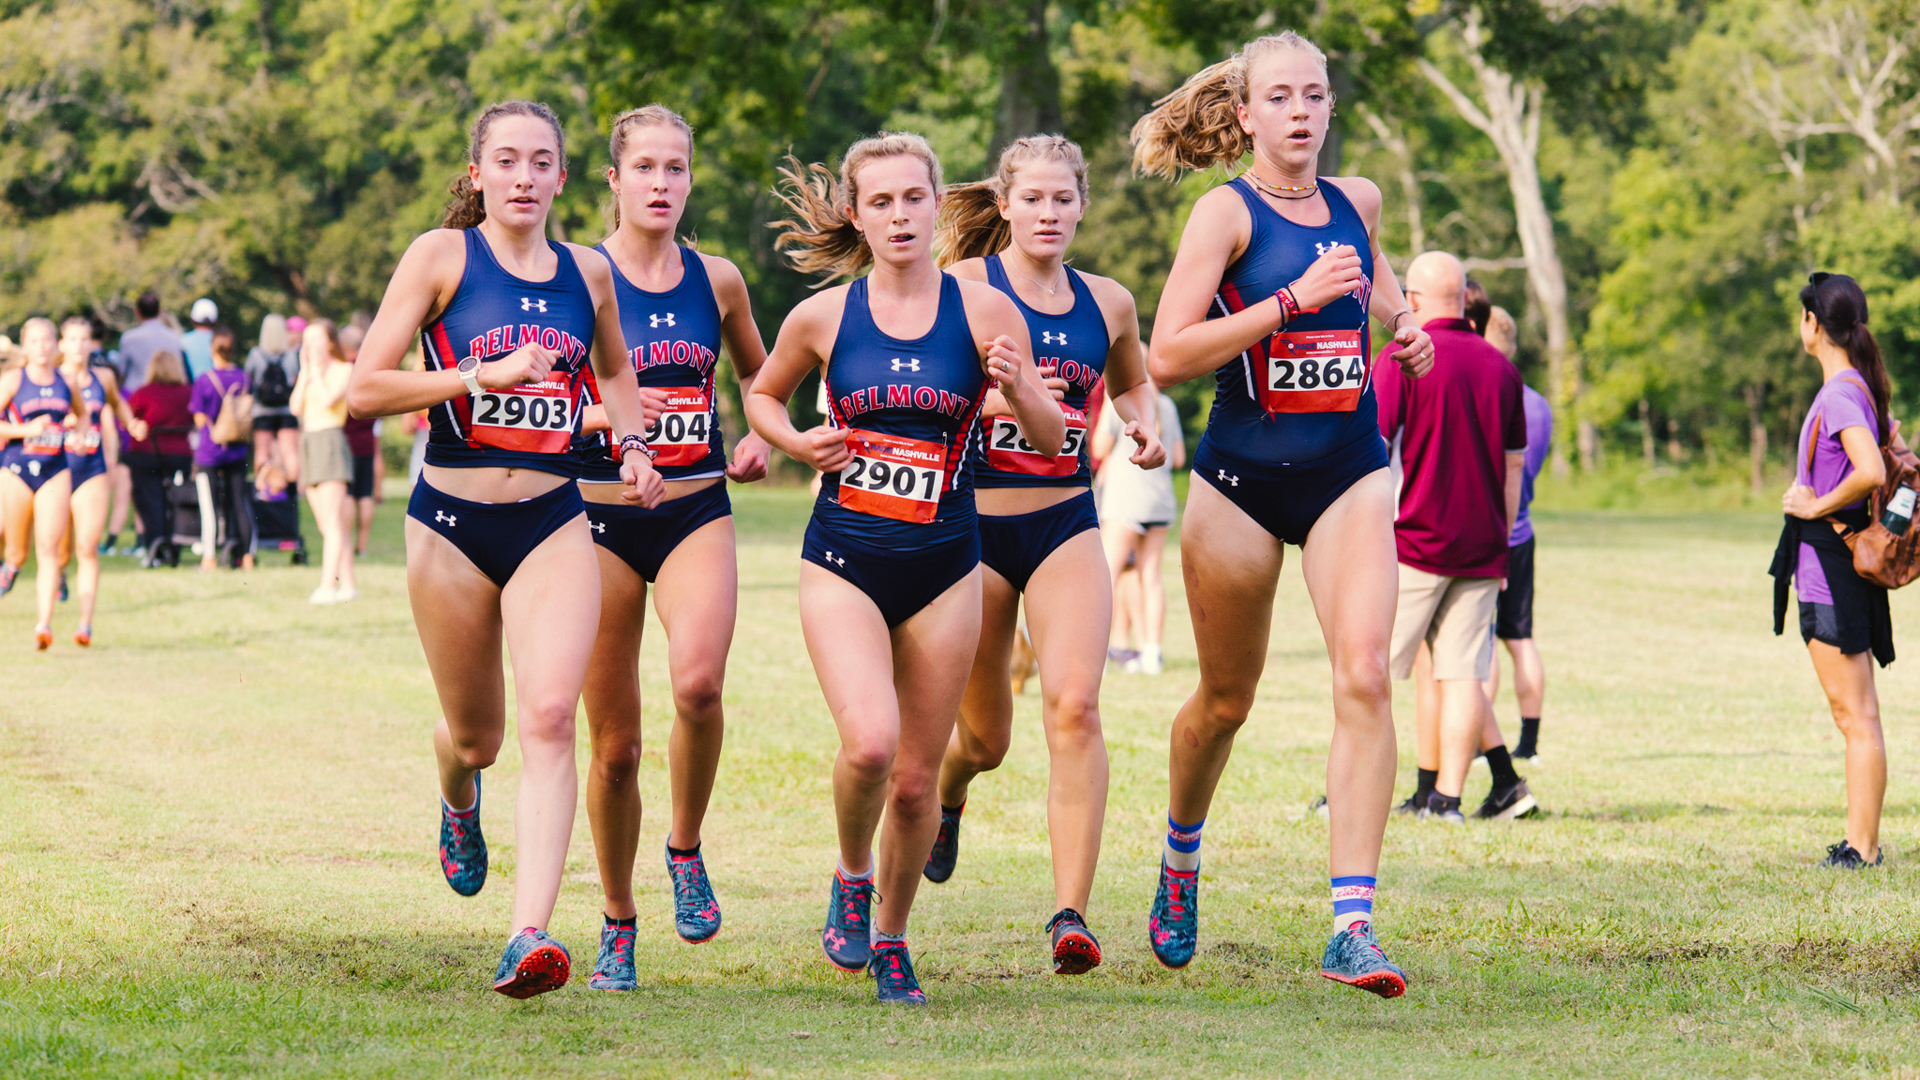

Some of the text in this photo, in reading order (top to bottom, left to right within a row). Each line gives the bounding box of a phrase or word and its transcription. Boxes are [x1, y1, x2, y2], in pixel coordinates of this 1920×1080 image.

[469, 324, 586, 370] BELMONT
[1273, 357, 1363, 390] 2864
[477, 394, 567, 430] 2903
[839, 384, 970, 421] BELMONT
[844, 453, 937, 501] 2901
